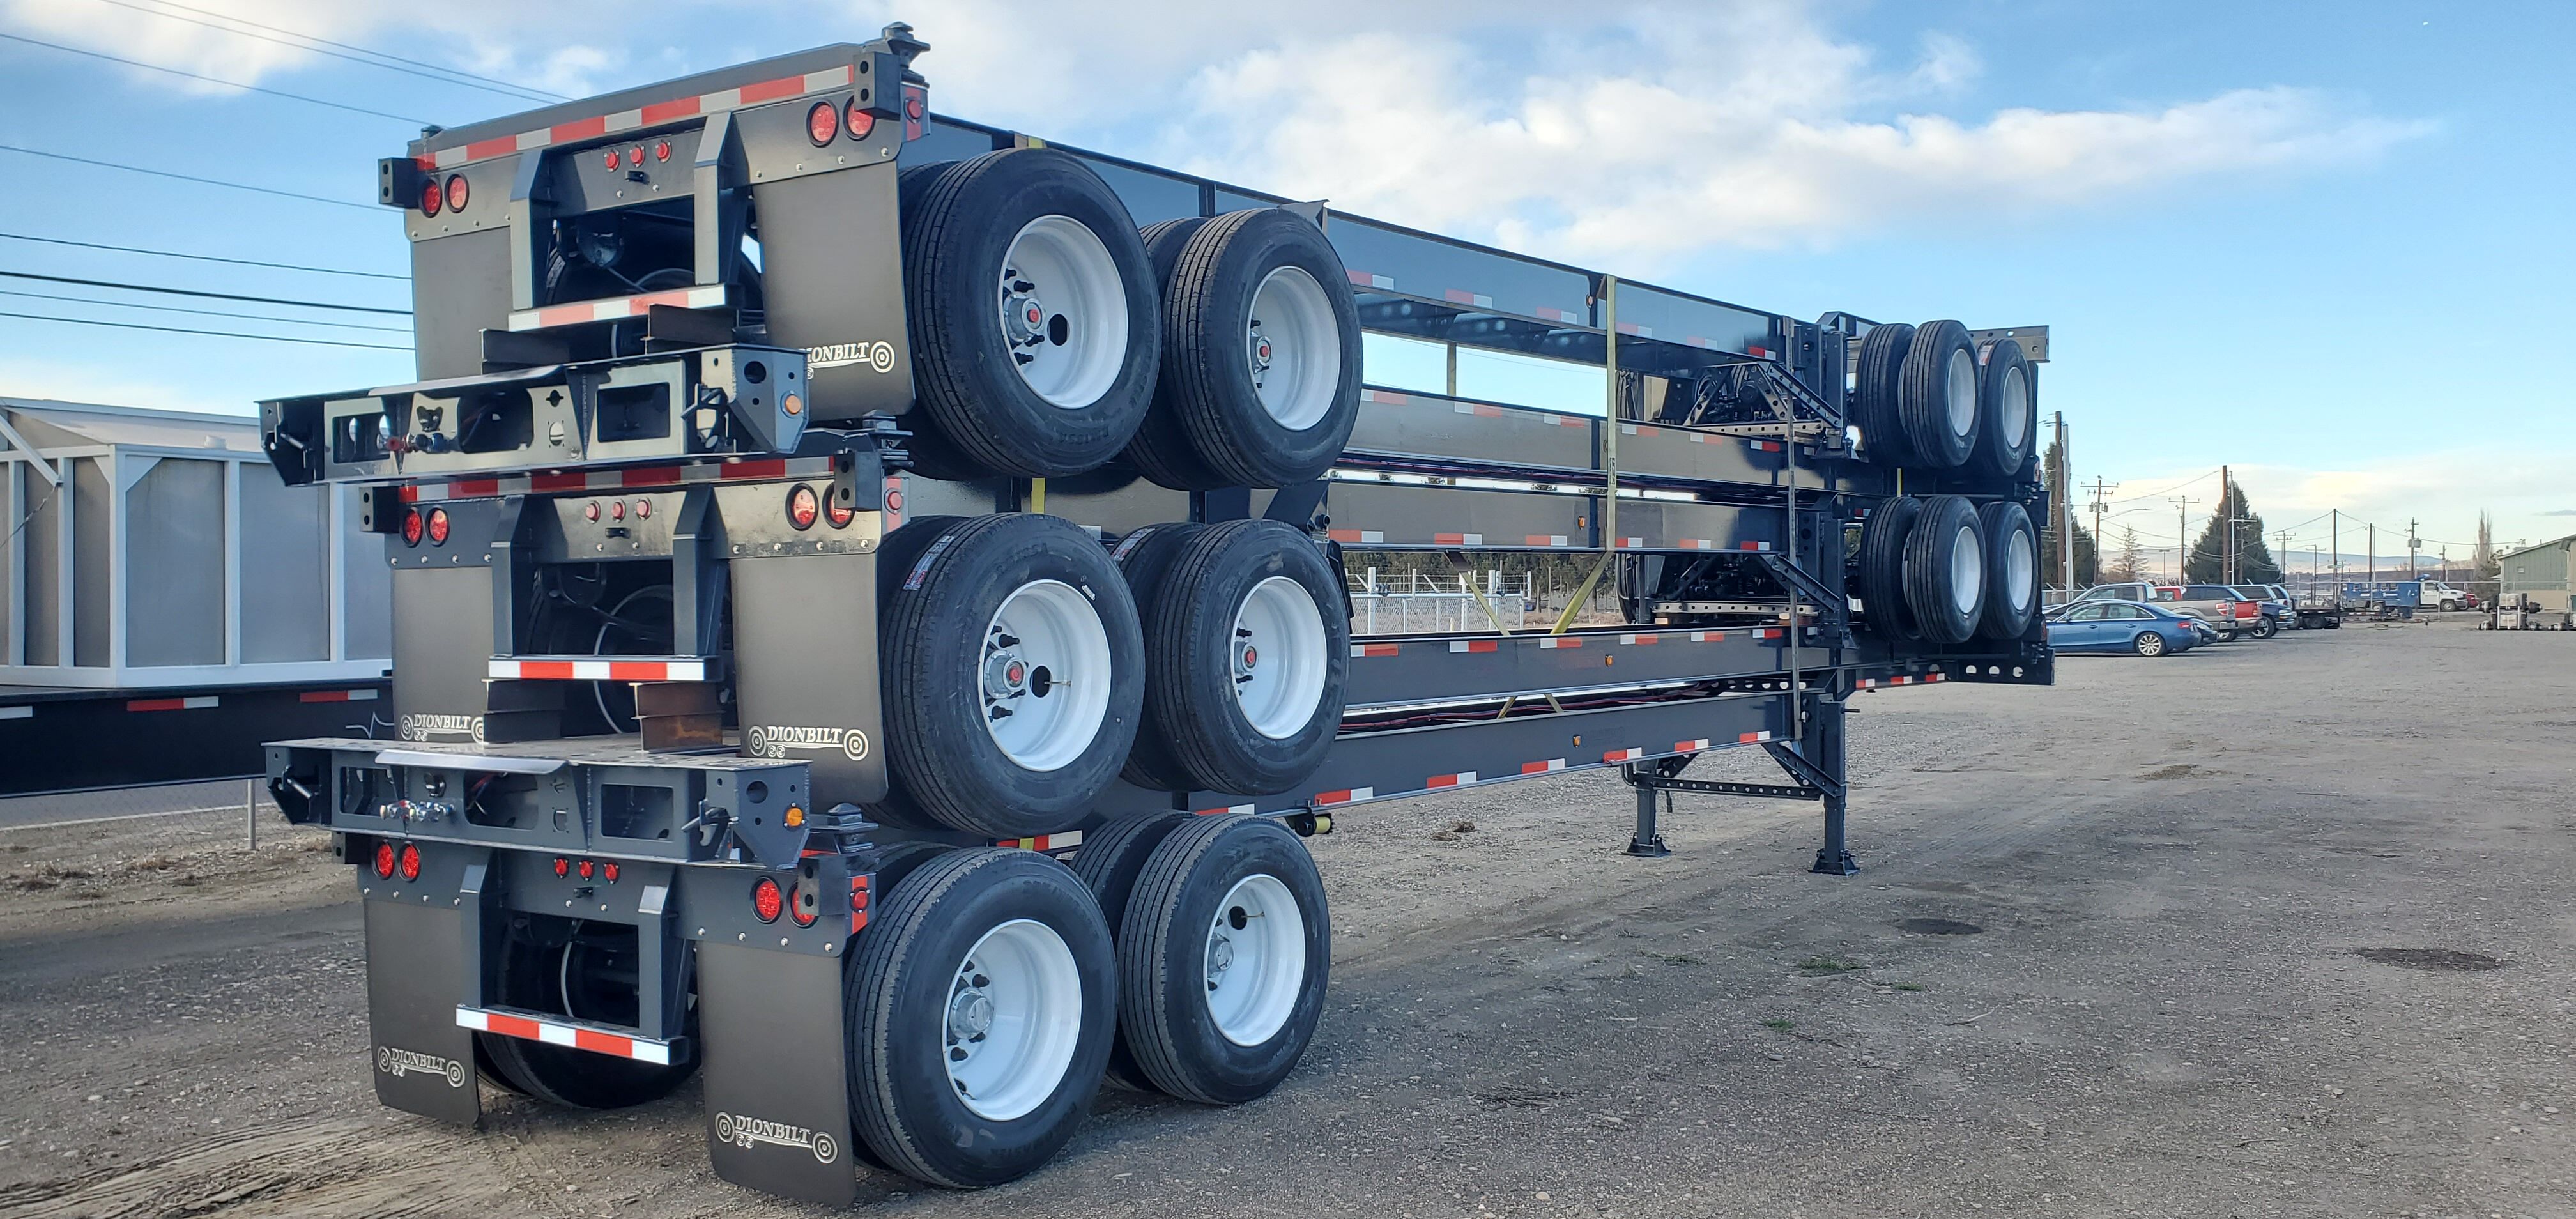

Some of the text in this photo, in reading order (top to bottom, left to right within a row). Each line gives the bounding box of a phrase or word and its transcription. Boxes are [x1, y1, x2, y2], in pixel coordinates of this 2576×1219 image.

[414, 714, 471, 729] DIONBILT
[767, 726, 843, 743] DIONBILT
[391, 1048, 445, 1070] DIONBILT
[735, 1115, 811, 1143] DIONBILT
